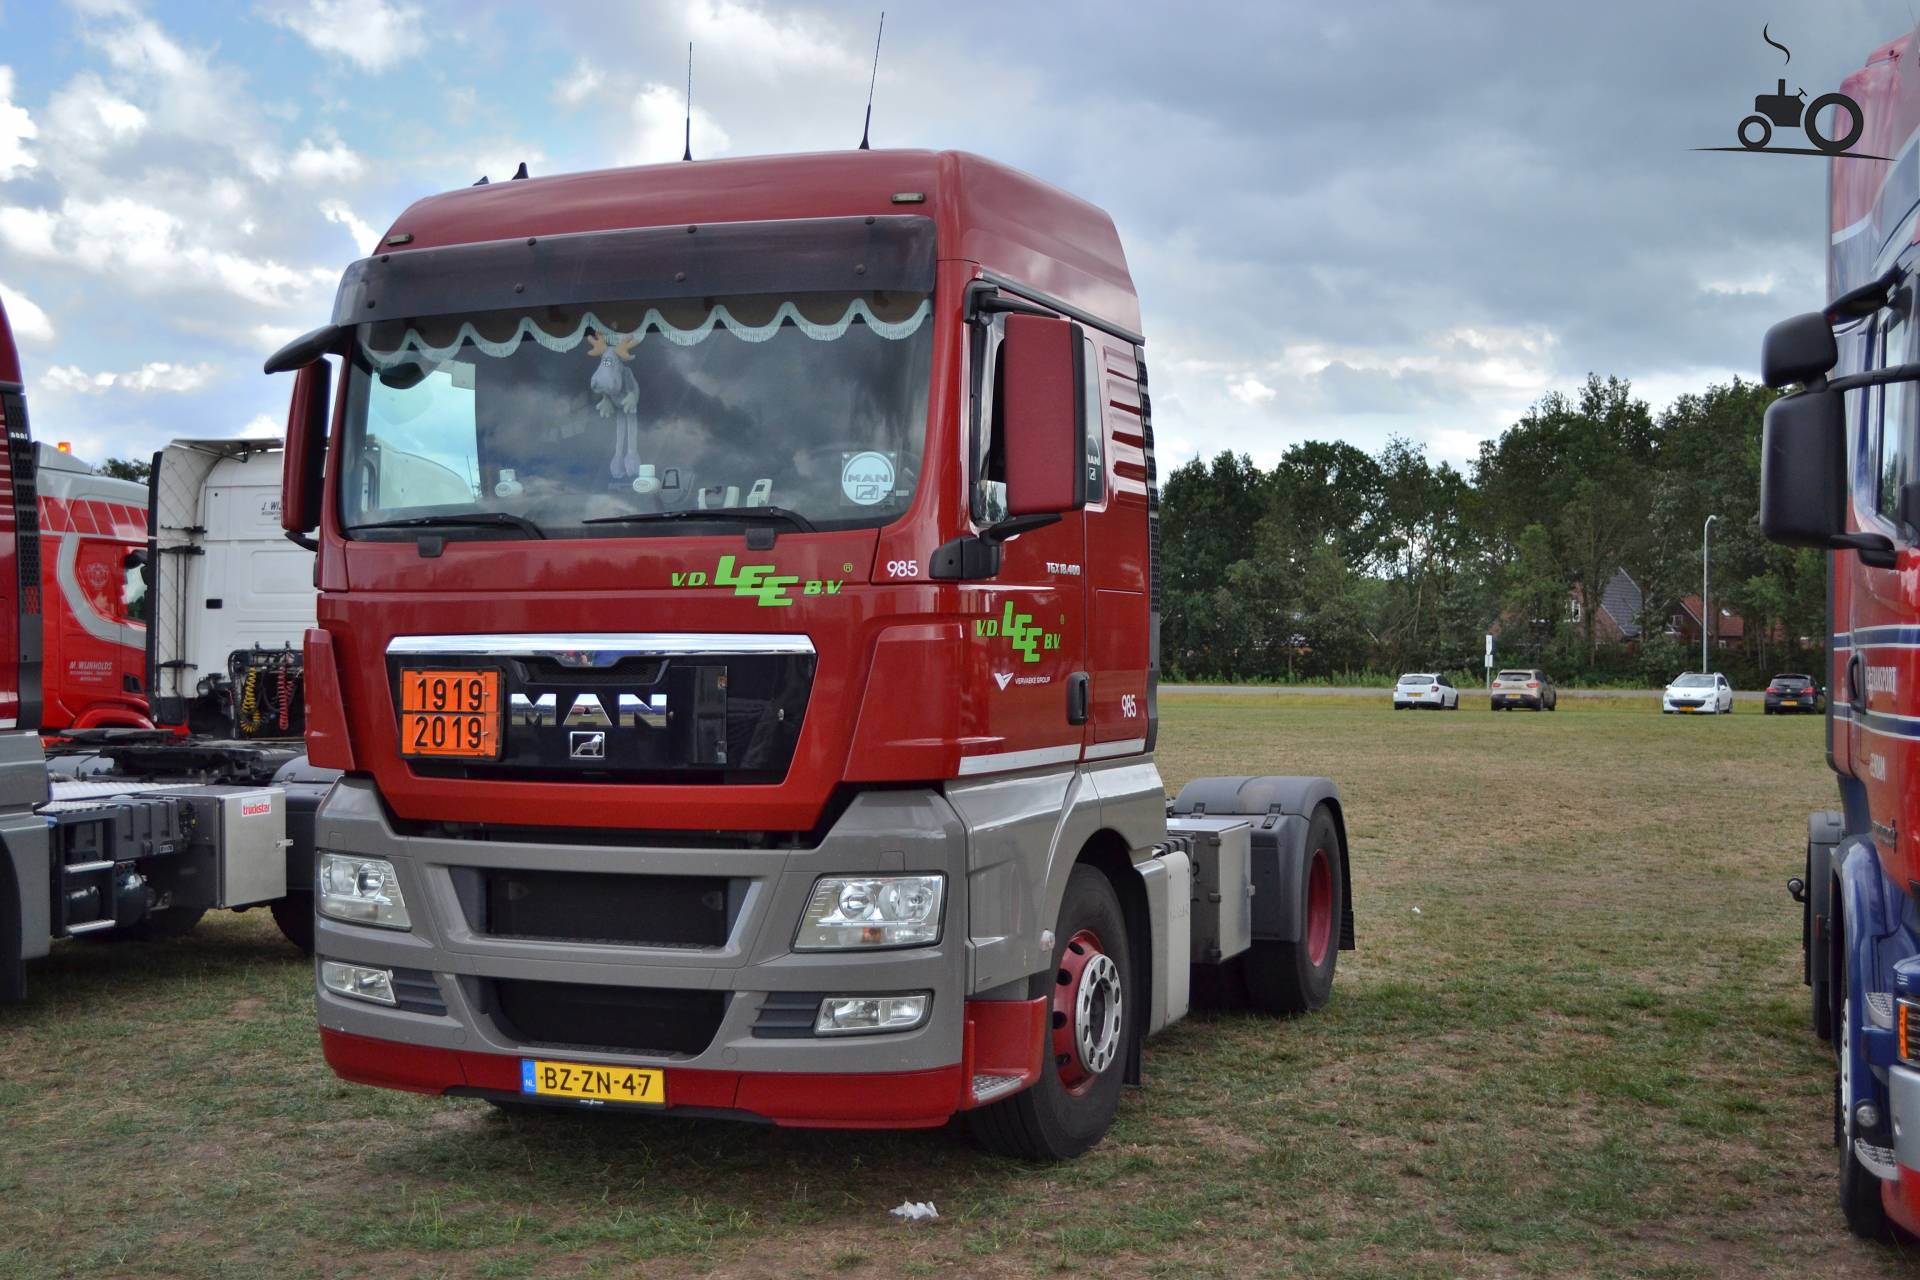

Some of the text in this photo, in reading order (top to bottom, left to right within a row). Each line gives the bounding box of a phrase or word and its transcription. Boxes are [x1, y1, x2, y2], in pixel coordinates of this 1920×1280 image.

[848, 474, 888, 482] MAN
[671, 555, 844, 606] V.D. LEE B.V.
[887, 560, 919, 577] 985
[1046, 562, 1060, 575] TGX
[976, 600, 1061, 663] V.D. LEE B.V.
[417, 679, 484, 711] 1919
[1122, 695, 1136, 718] 985
[511, 693, 667, 728] MAN
[415, 716, 482, 749] 2019
[525, 1079, 535, 1087] NL
[544, 1067, 652, 1097] BZ-ZN-47
